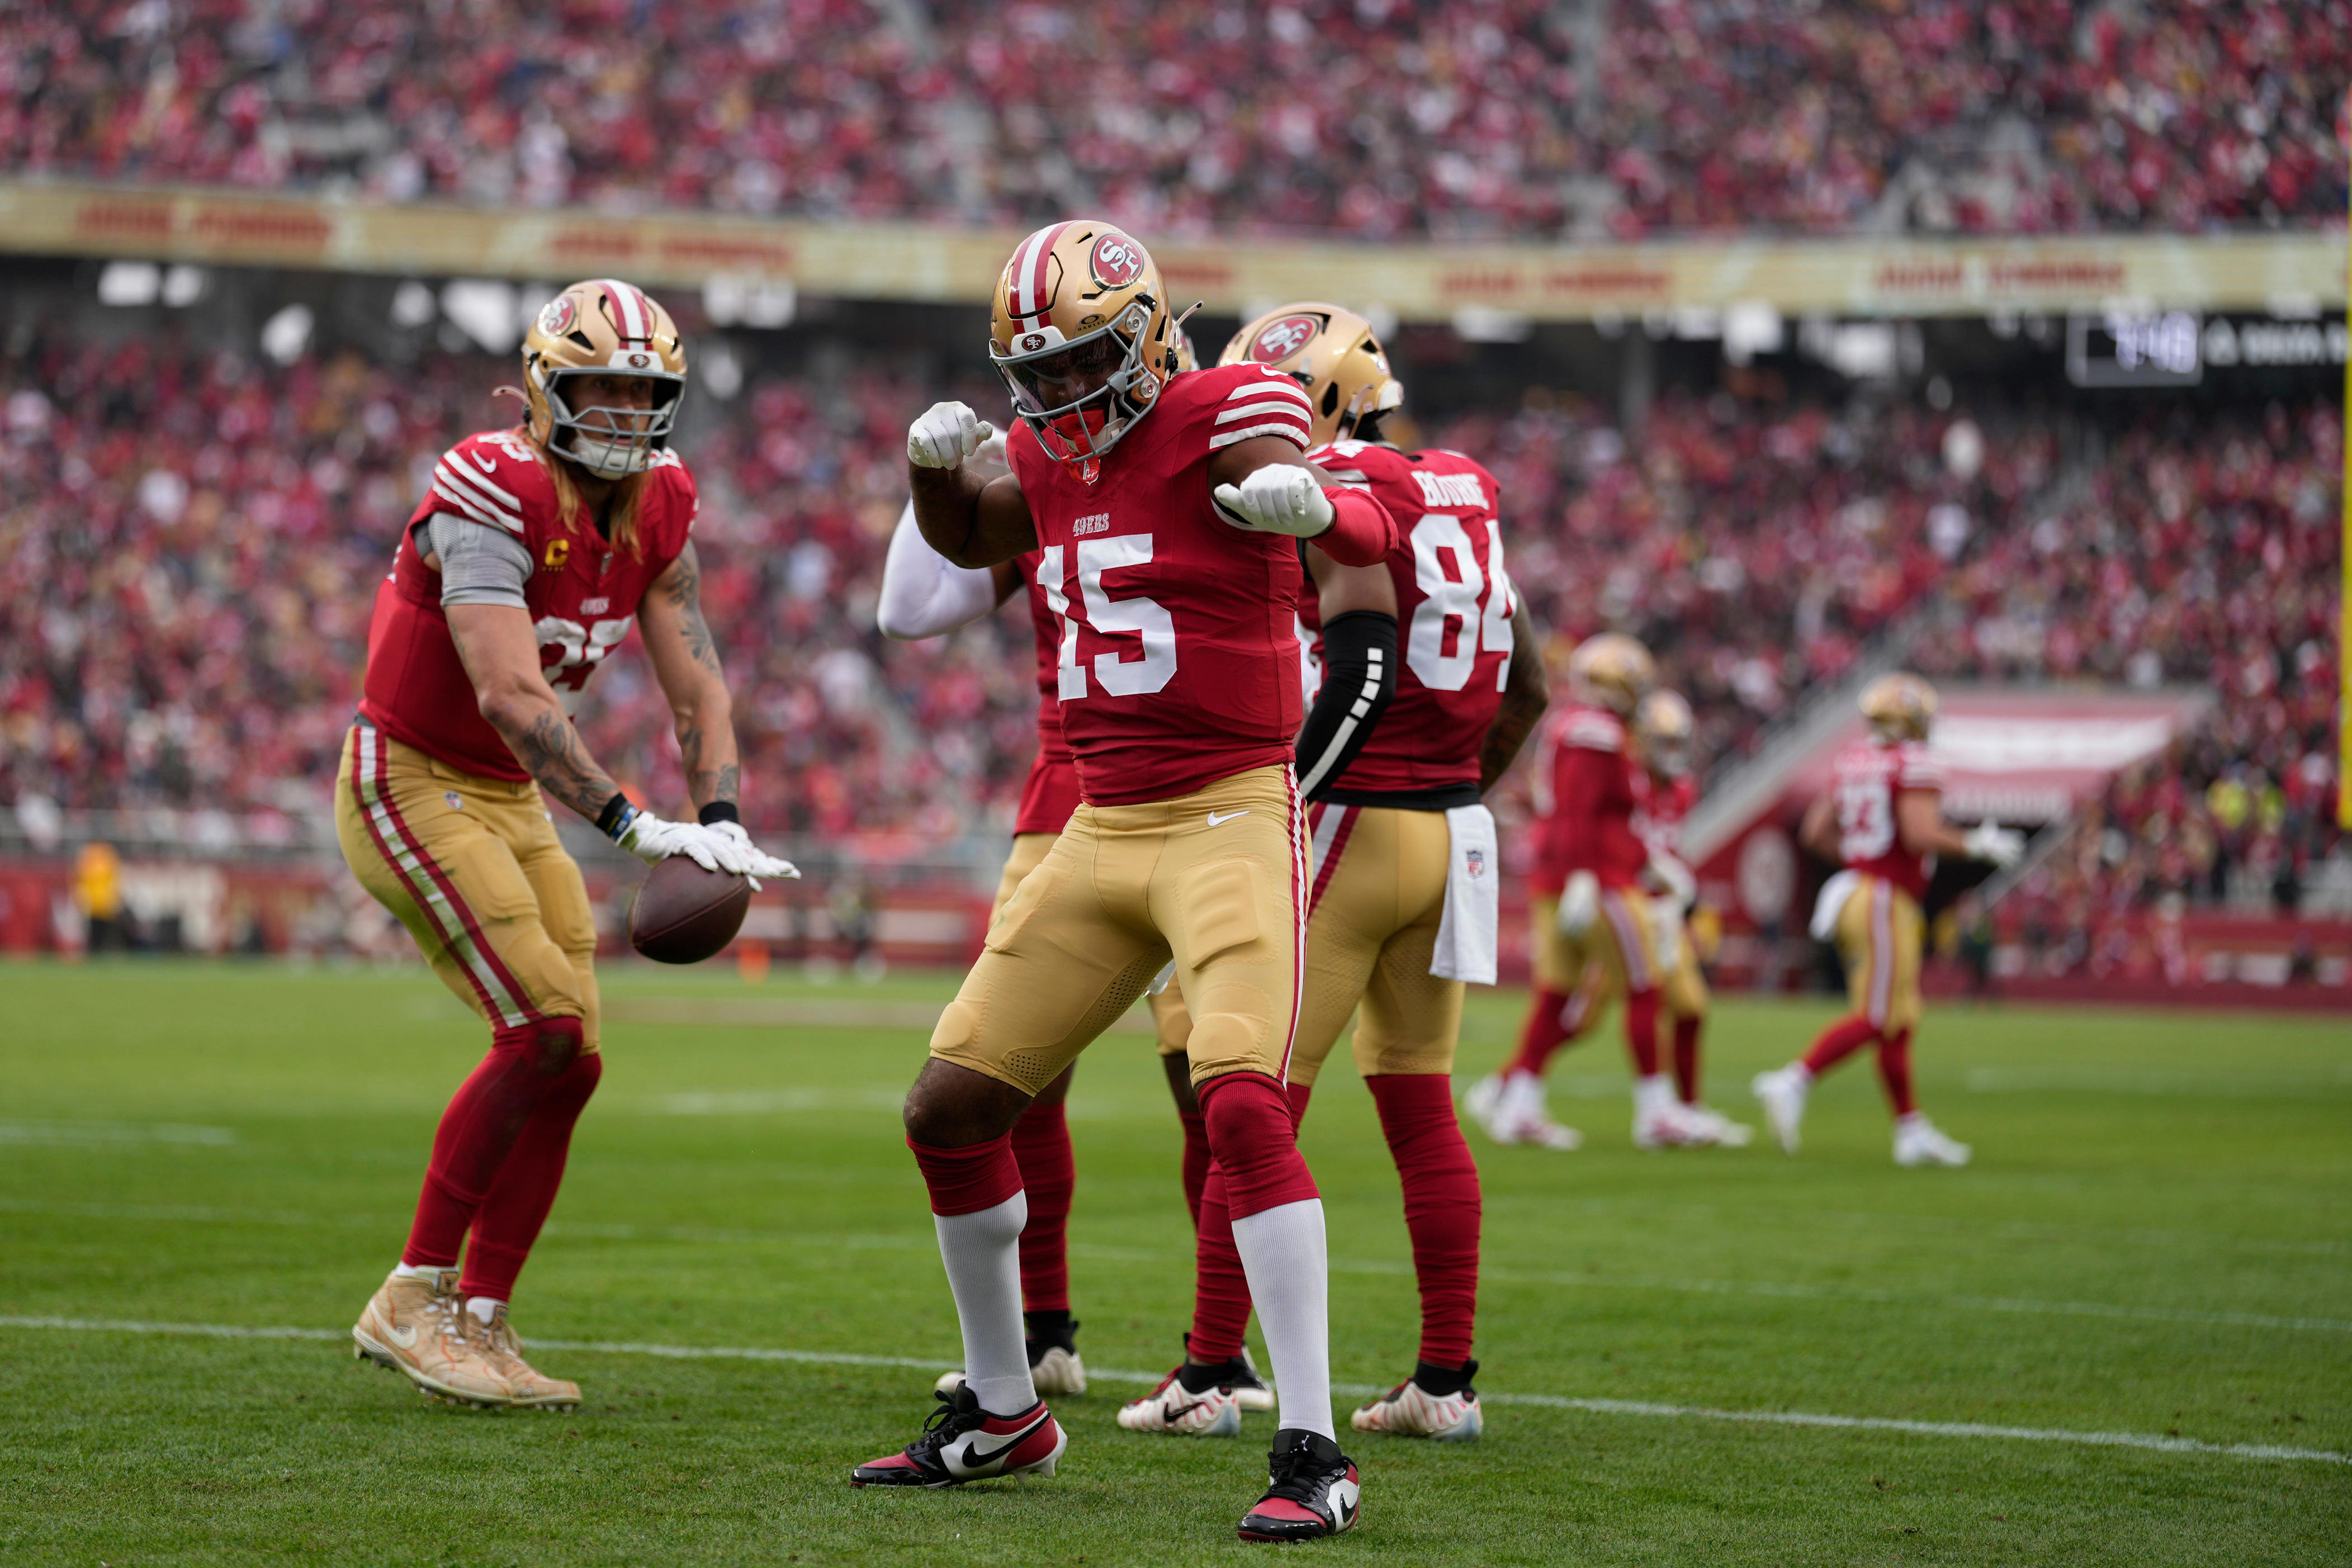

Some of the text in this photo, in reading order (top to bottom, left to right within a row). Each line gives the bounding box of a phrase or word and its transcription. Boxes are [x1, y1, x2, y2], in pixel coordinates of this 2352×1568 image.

[1077, 319, 1105, 332] OAKLEY
[1410, 470, 1490, 511] BOURNE
[1072, 512, 1110, 537] 49ERS
[545, 539, 569, 566] C
[1037, 533, 1177, 702] 15
[1406, 513, 1518, 693] 84
